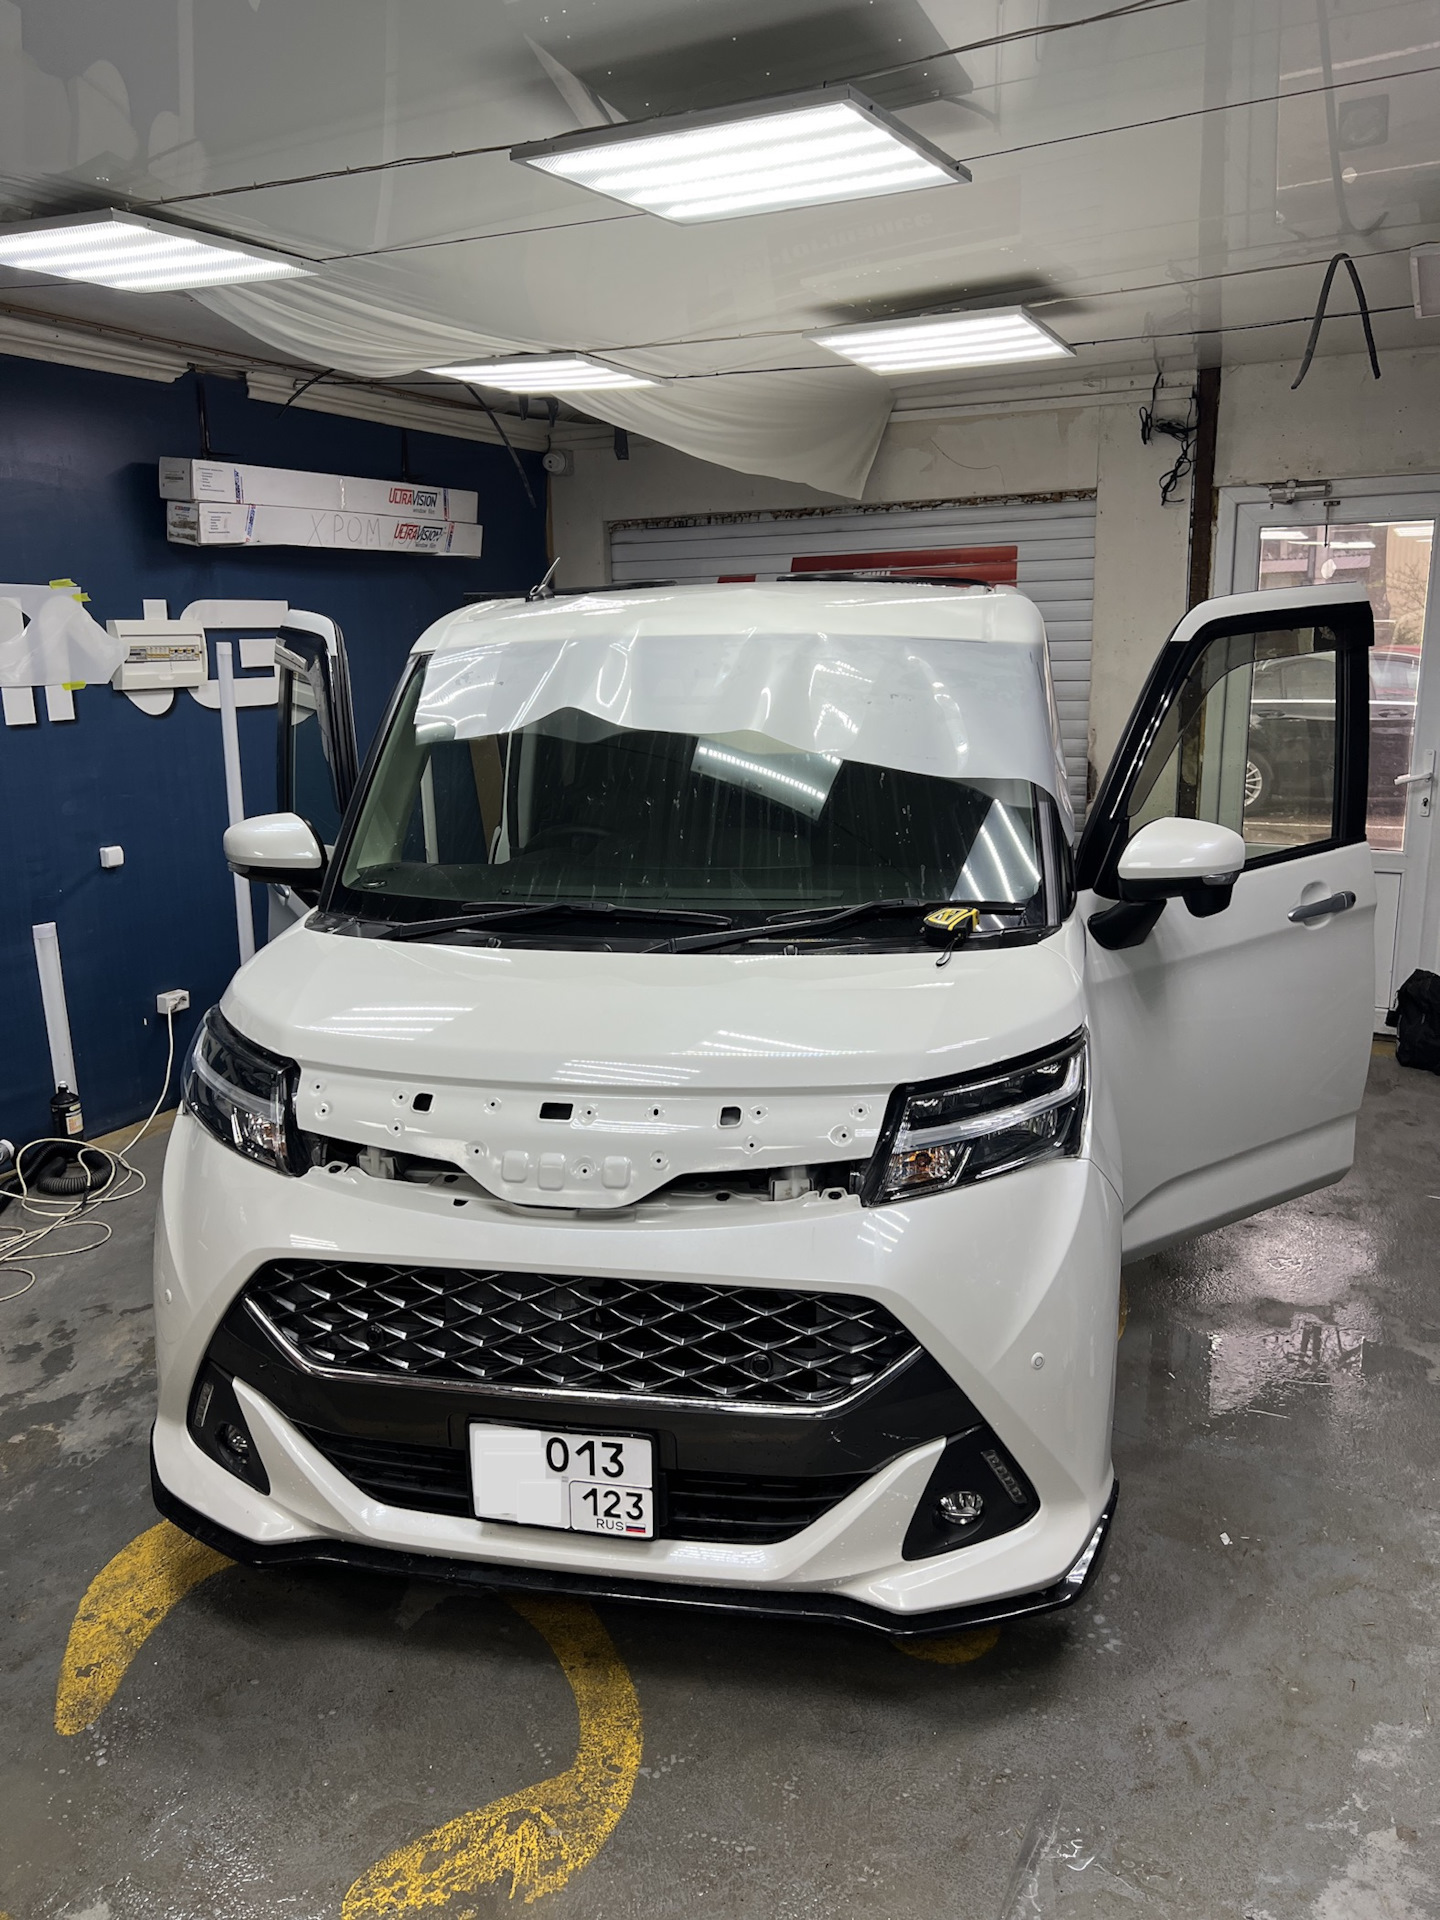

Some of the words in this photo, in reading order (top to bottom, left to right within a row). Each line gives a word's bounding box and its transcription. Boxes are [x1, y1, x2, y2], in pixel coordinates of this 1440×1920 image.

[389, 487, 437, 508] ULTRAVISION
[546, 1437, 625, 1478] 013
[582, 1488, 644, 1520] 123
[596, 1518, 624, 1531] RUS
